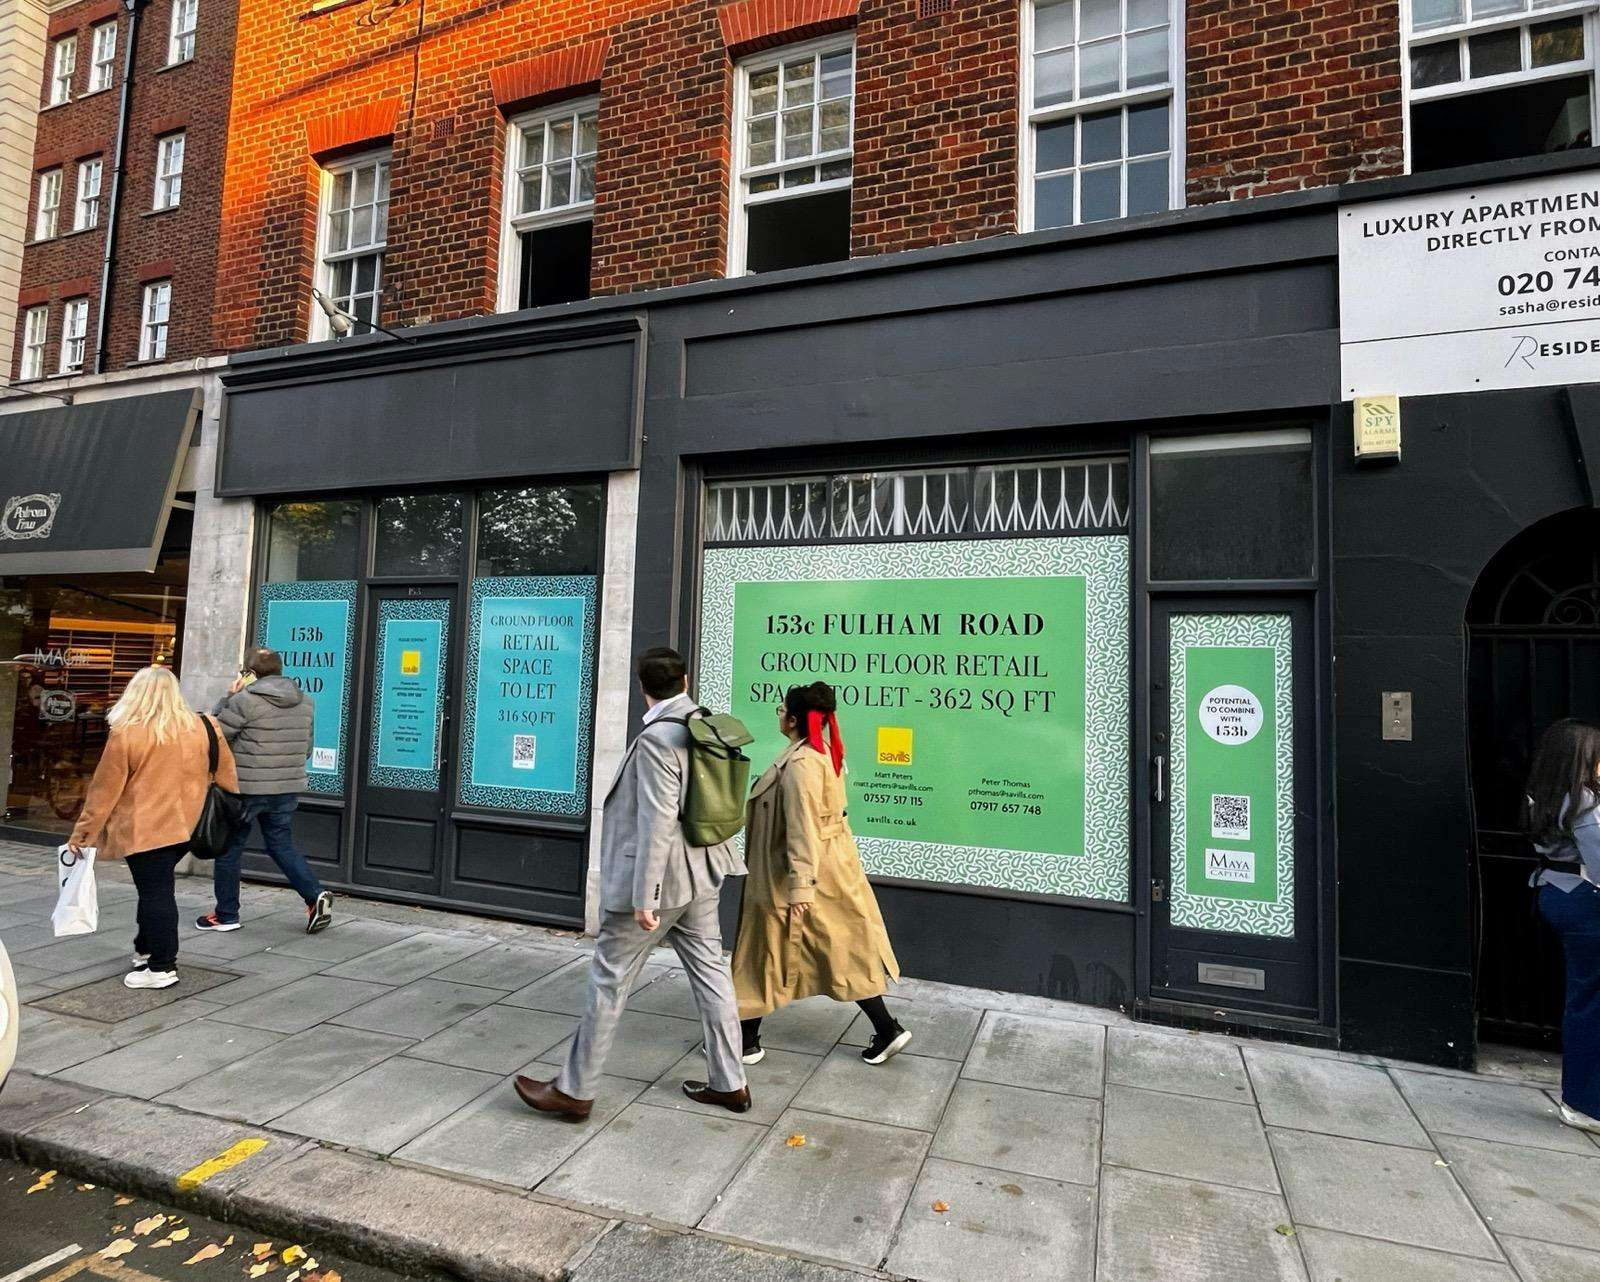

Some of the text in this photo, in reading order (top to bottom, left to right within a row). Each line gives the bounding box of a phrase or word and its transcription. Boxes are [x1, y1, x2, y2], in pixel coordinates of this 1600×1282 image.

[1363, 190, 1600, 237] LUXURY APARTMEN
[1427, 224, 1532, 252] DIRECTLY
[1544, 246, 1600, 262] CONTA
[1498, 265, 1600, 296] 020 74
[1499, 295, 1600, 315] sasha@resid
[1365, 415, 1393, 427] SPY
[490, 615, 574, 627] GROUND FLOOR
[766, 613, 1044, 636] 153c FULHAM ROAD
[289, 627, 323, 642] 153b
[503, 634, 559, 651] RETAIL
[502, 657, 552, 675] SPACE
[760, 652, 1048, 677] GROUND FLOOR RETAIL
[282, 676, 324, 693] OAD
[500, 681, 556, 699] TO LET
[750, 682, 812, 703] SPA
[828, 685, 859, 706] TO
[864, 685, 910, 708] LET
[929, 687, 973, 710] 362
[981, 689, 1015, 717] SQ
[1023, 690, 1056, 713] FT
[1209, 697, 1251, 705] POTENTIAL
[498, 709, 555, 726] 316 SQ FT
[1216, 725, 1248, 737] 153b
[880, 751, 910, 763] savills
[892, 772, 913, 780] Peters
[981, 778, 1031, 788] Peter Thomas
[853, 781, 933, 792] matt.peters@savills.com
[968, 788, 1044, 800] pthomas@savills.com
[863, 793, 923, 806] 07557 517 115
[970, 801, 1041, 815] 07917 657 748
[1210, 852, 1250, 870] MAYA
[1210, 869, 1250, 879] CAPITAL
